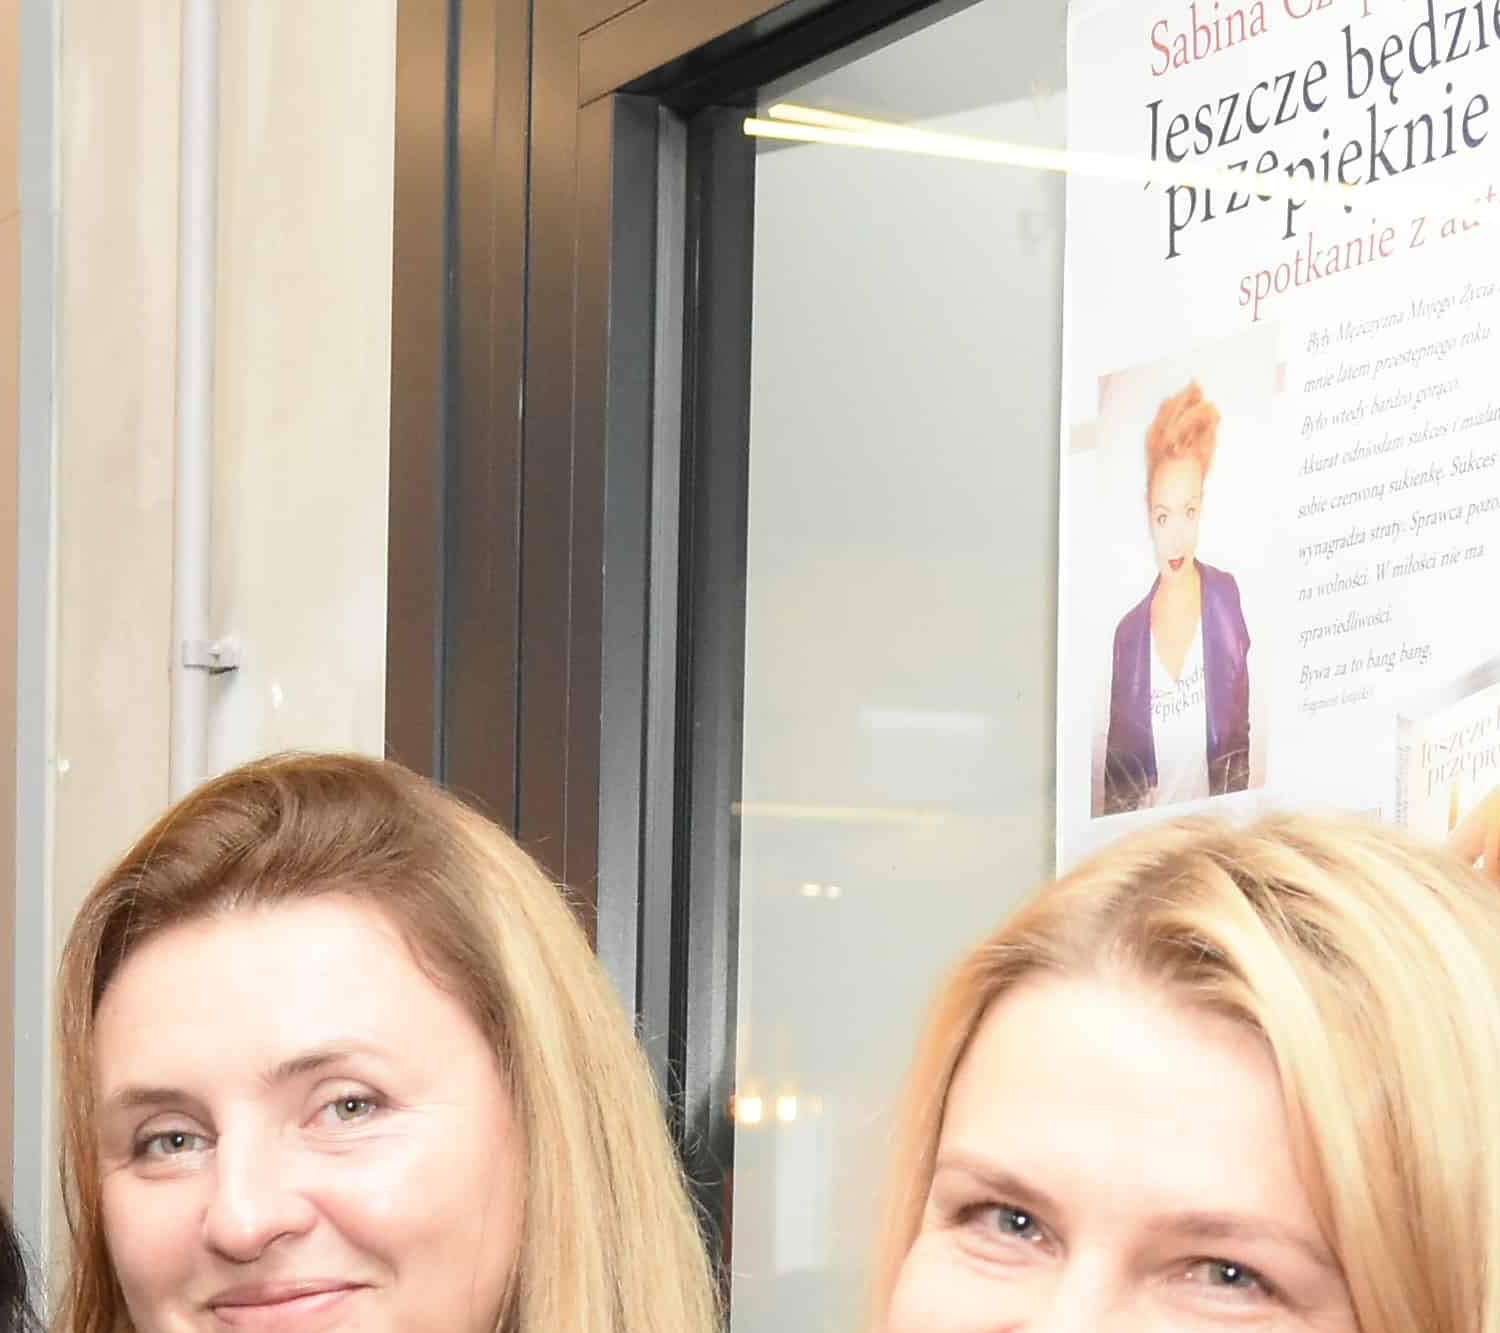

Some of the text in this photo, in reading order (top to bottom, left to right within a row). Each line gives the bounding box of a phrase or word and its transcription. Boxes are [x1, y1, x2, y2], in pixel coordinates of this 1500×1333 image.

[1150, 1, 1268, 76] Sabina
[1144, 60, 1327, 190] Jeszcze
[1164, 82, 1490, 259] przepięknie
[1239, 217, 1396, 321] spotkanie
[1410, 215, 1427, 248] z
[1449, 449, 1496, 477] Sukces
[1409, 505, 1463, 537] Sprawca
